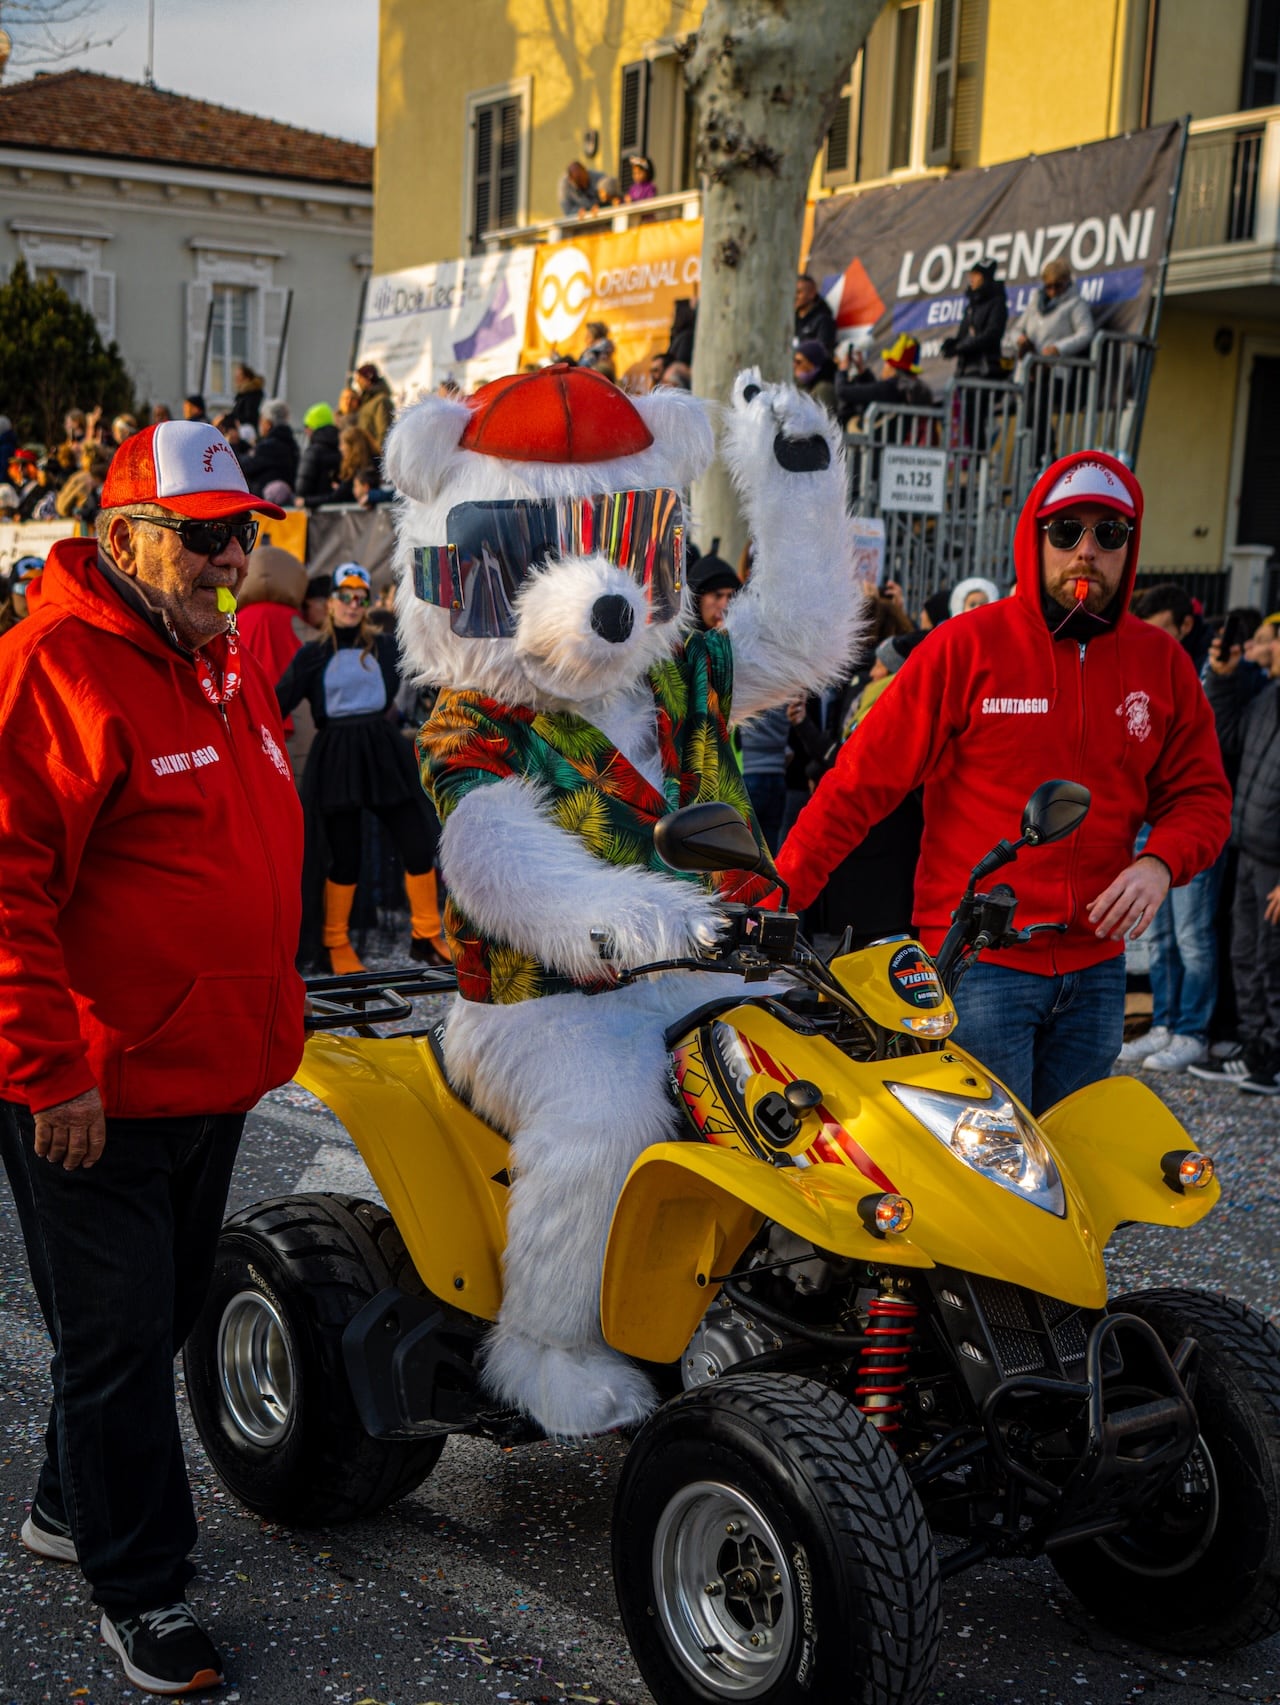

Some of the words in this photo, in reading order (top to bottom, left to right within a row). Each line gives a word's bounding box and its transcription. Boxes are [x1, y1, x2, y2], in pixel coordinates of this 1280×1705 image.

[897, 208, 1156, 298] LORENZONI
[595, 260, 679, 297] ORIGINAL
[927, 301, 965, 325] EDIL
[896, 471, 932, 487] n.125
[982, 697, 1049, 714] SALVATAGGIO
